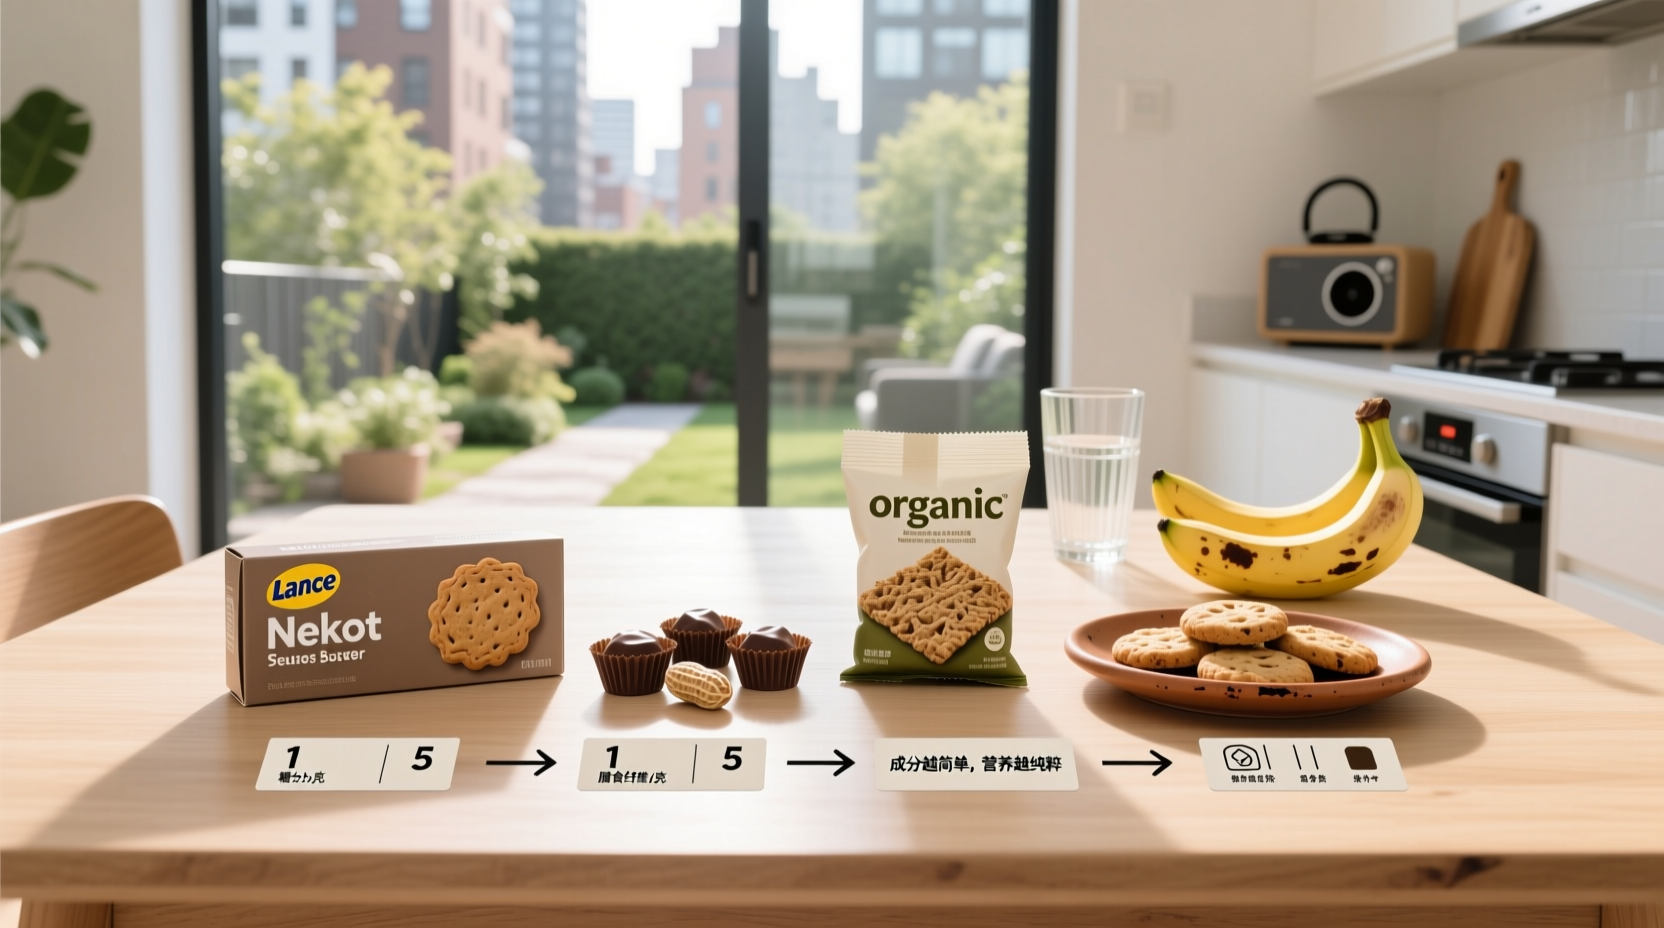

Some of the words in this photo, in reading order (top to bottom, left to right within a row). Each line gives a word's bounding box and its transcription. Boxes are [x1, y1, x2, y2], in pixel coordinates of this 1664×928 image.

[869, 487, 1004, 529] organic
[272, 574, 336, 601] Lance
[268, 611, 382, 649] Nekot
[287, 746, 301, 769] 1
[411, 746, 434, 771] 5
[606, 745, 619, 769] 1
[721, 746, 743, 771] 5
